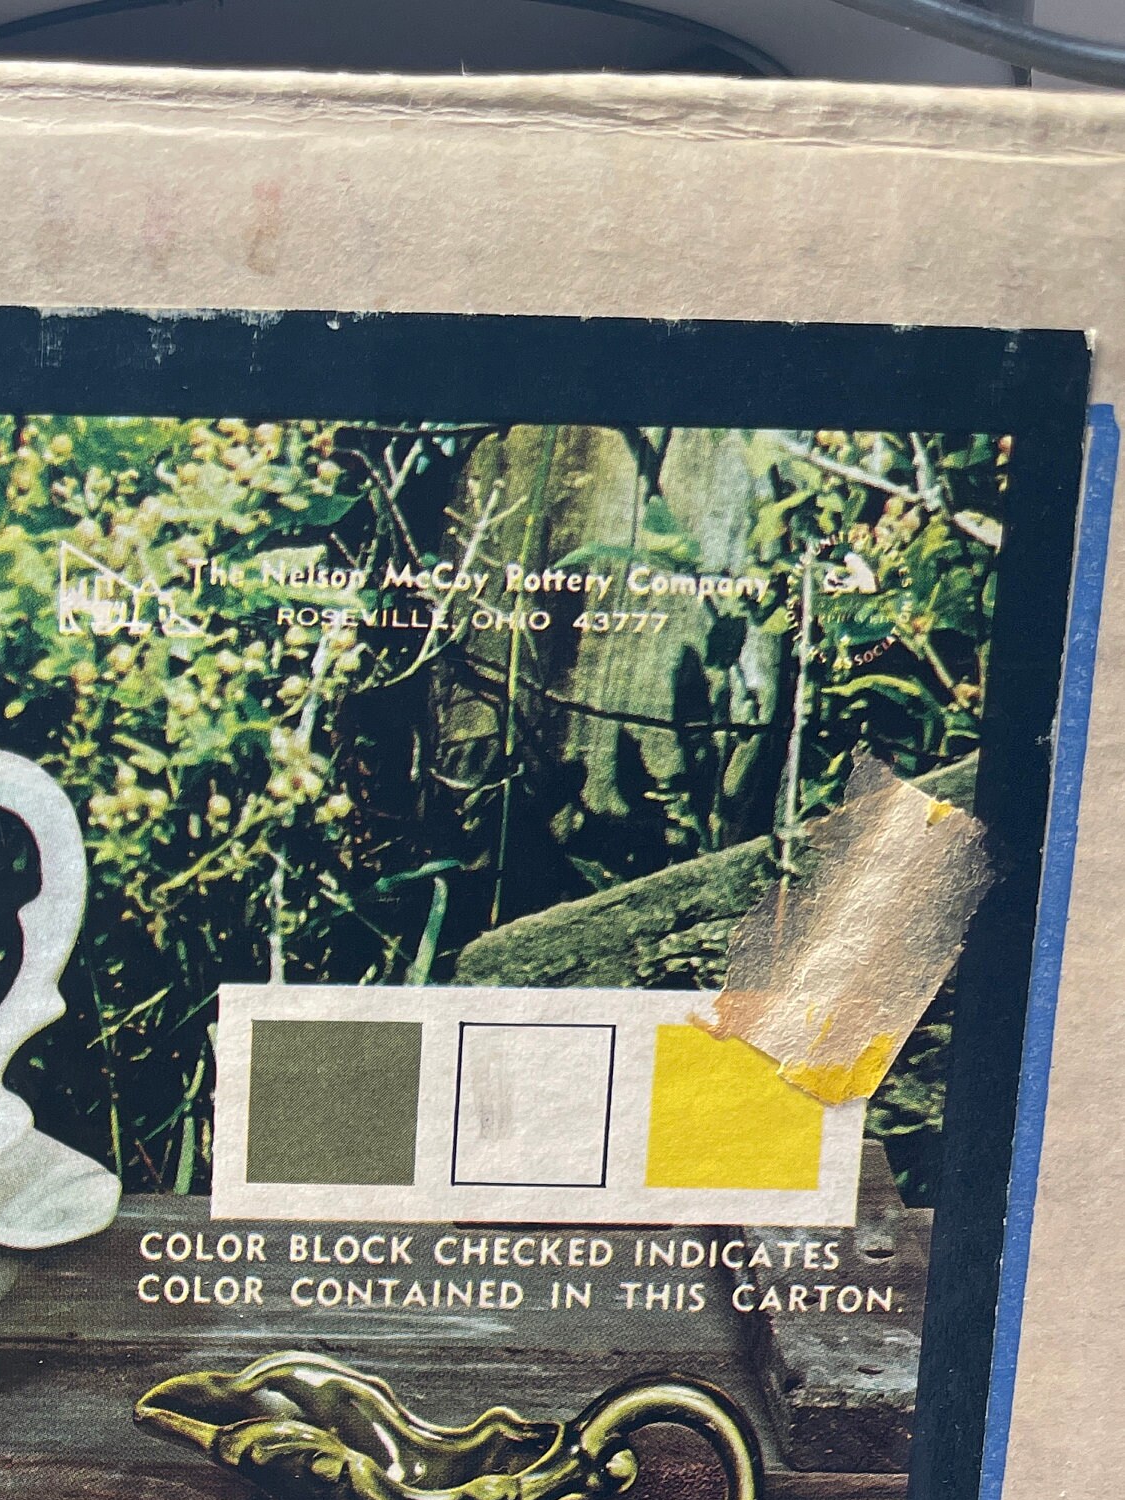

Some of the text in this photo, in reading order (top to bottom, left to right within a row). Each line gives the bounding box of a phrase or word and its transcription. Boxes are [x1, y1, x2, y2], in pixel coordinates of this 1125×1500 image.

[189, 559, 244, 588] The
[263, 562, 365, 589] Nelson
[384, 563, 489, 601] McCoy
[505, 563, 613, 602] Pottery
[628, 565, 770, 602] Company
[472, 608, 551, 631] OHIO
[573, 611, 669, 635] 43777
[139, 1231, 841, 1271] COLOR BLOCK CHECKED INDICATES
[137, 1273, 904, 1314] COLOR CONTAINED IN THIS CARTON.
